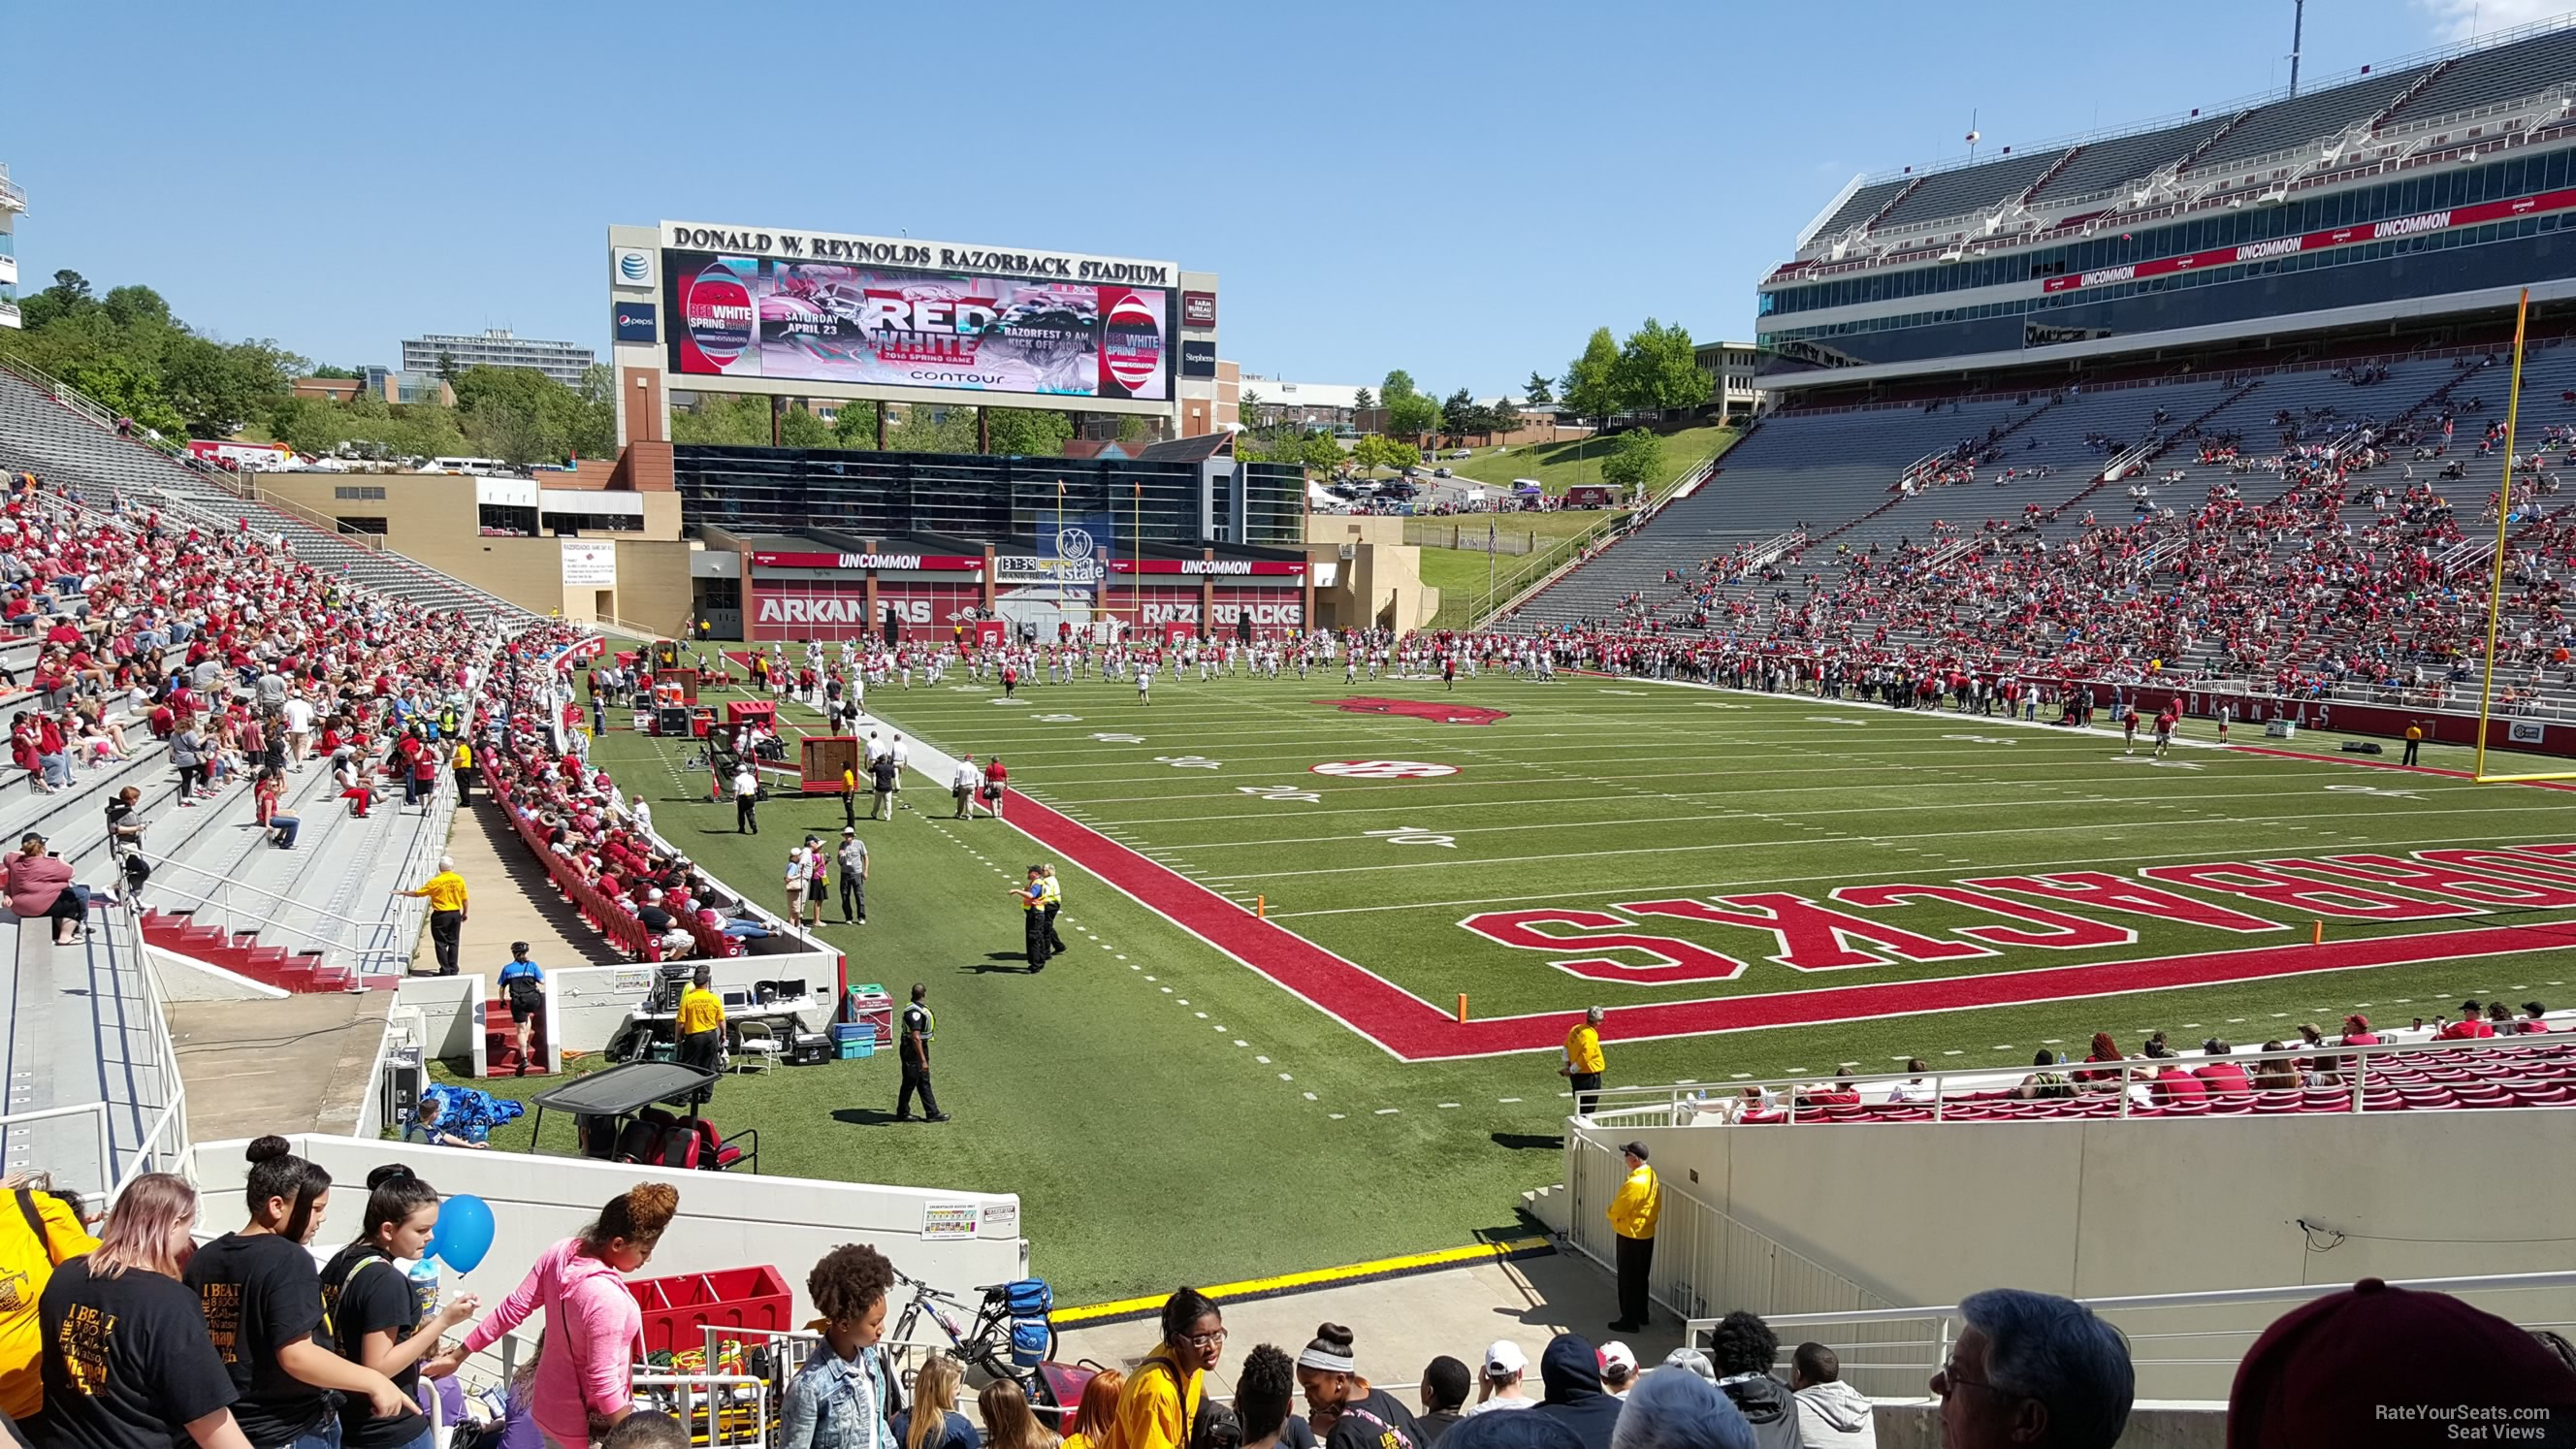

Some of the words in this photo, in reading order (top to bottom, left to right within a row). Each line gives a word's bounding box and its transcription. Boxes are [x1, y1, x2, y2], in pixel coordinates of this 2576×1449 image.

[2374, 211, 2452, 238] UNCOMMON
[673, 227, 772, 253] DONALD
[779, 236, 804, 257] W.
[811, 238, 931, 266] REYNOLDS
[940, 248, 1072, 277] RAZORBACK
[1079, 260, 1167, 284] STADIUM
[2237, 237, 2302, 261] UNCOMMON
[2080, 265, 2136, 287] UNCOMMON
[630, 317, 654, 326] pepsi
[785, 311, 840, 325] SATURDAY
[867, 296, 998, 335] RED
[788, 323, 821, 336] APRIL
[823, 325, 838, 336] 23
[1004, 327, 1061, 339] RAZORFEST
[1065, 331, 1072, 339] 9
[1074, 331, 1089, 340] AM
[871, 329, 982, 356] WHITE
[1008, 338, 1033, 349] KICK
[1036, 339, 1054, 350] OFF
[1058, 341, 1086, 352] NOON
[885, 352, 907, 361] 2016
[909, 354, 944, 363] SPRING
[946, 355, 972, 365] GAME
[1185, 352, 1214, 363] Stephens
[839, 554, 921, 570] UNCOMMON
[1004, 558, 1037, 570] 37:39
[1181, 560, 1252, 575] UNCOMMON
[997, 572, 1027, 581] FRANK
[759, 598, 931, 624] ARKANSAS
[1236, 785, 1317, 802] 20
[1364, 826, 1455, 848] 10
[203, 1283, 209, 1297] I
[211, 1283, 242, 1297] BEAT
[68, 1303, 78, 1319] I
[58, 1319, 75, 1343] THE
